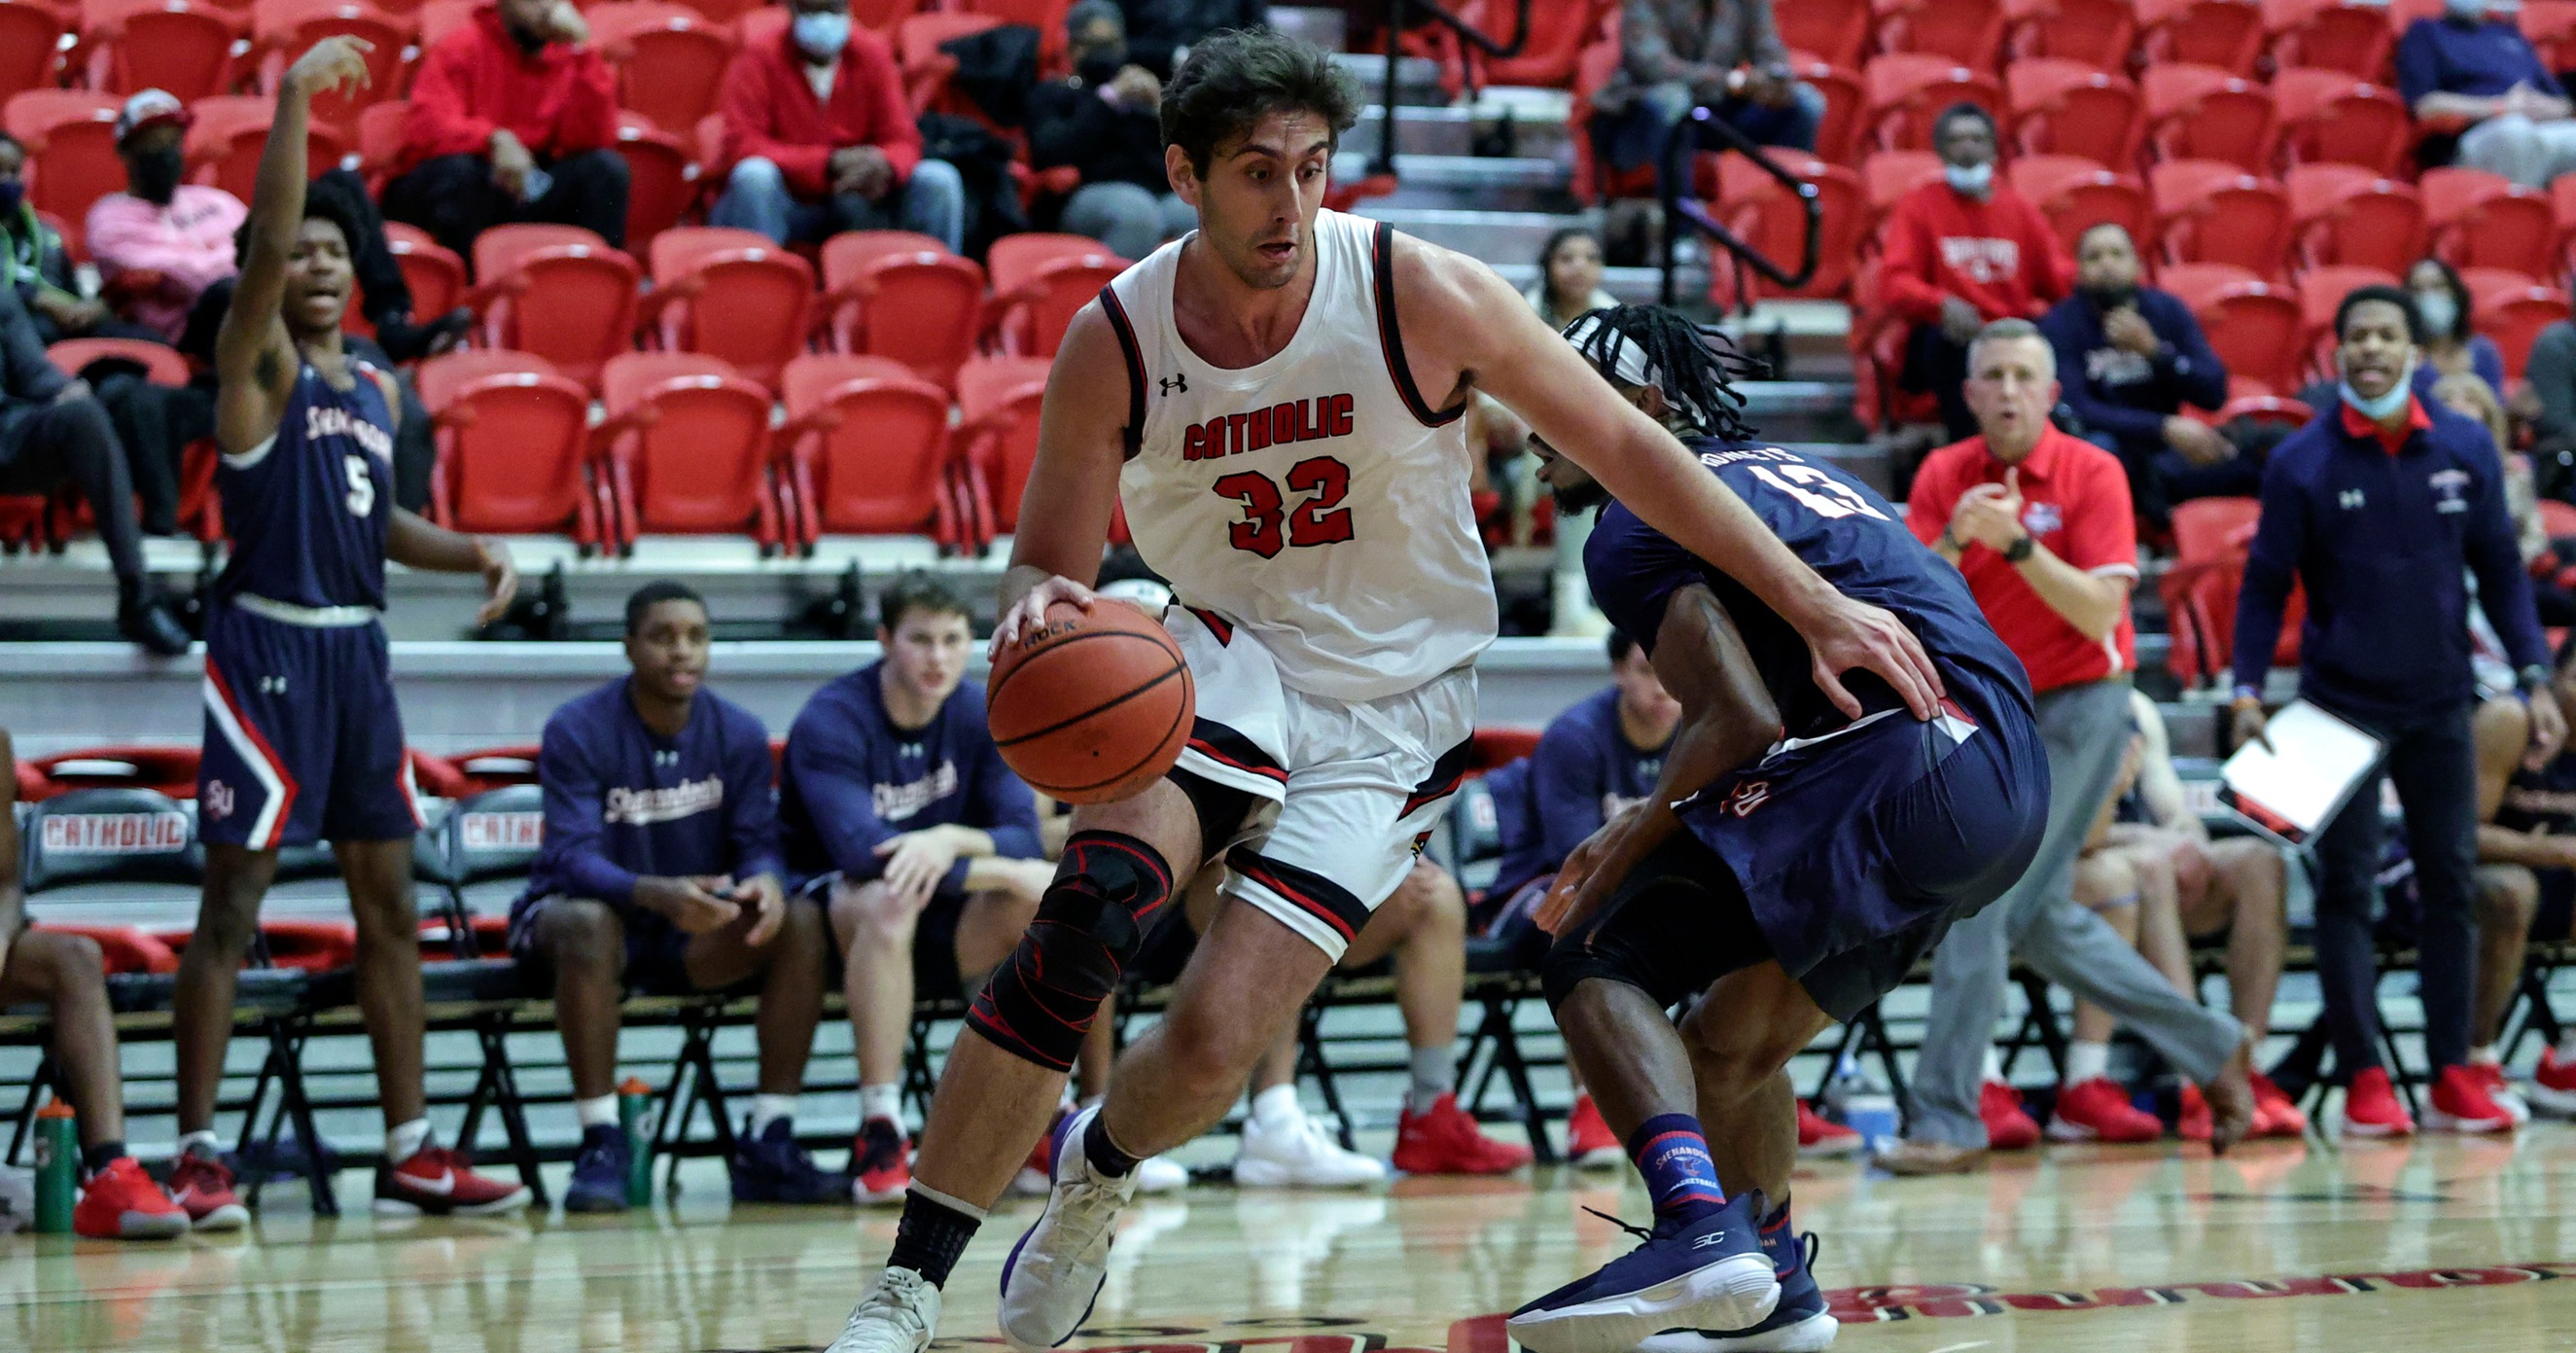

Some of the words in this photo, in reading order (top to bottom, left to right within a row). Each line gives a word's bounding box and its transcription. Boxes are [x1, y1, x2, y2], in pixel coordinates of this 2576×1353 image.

[1182, 393, 1354, 462] CATHOLIC
[343, 454, 375, 517] 5
[1212, 455, 1355, 560] 32
[1747, 464, 1891, 519] 13
[45, 817, 185, 849] CATHOLIC
